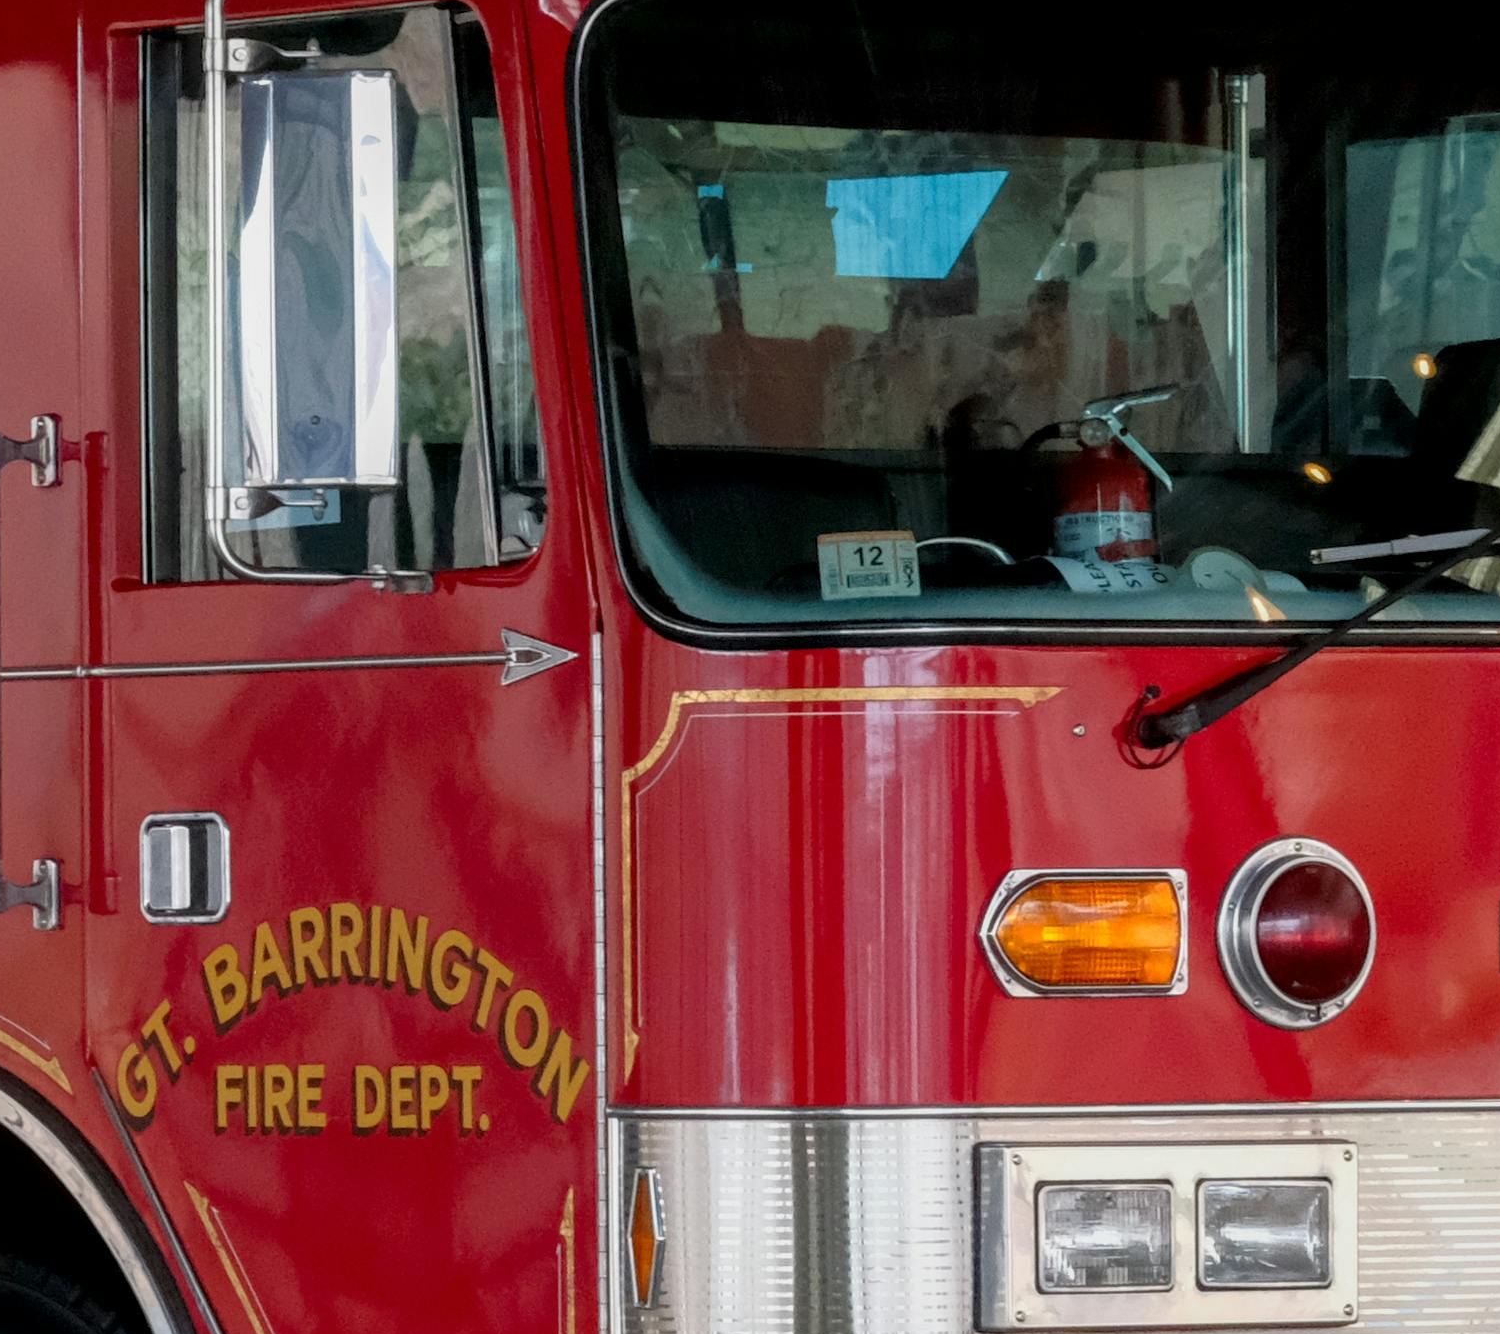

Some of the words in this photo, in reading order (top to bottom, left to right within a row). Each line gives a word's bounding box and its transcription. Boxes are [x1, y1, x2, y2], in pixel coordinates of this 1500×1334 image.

[853, 546, 884, 567] 12
[116, 999, 197, 1120] GT.
[202, 902, 590, 1124] BARRINGTON
[216, 1064, 327, 1129] FIRE
[353, 1064, 491, 1132] DEPT.
